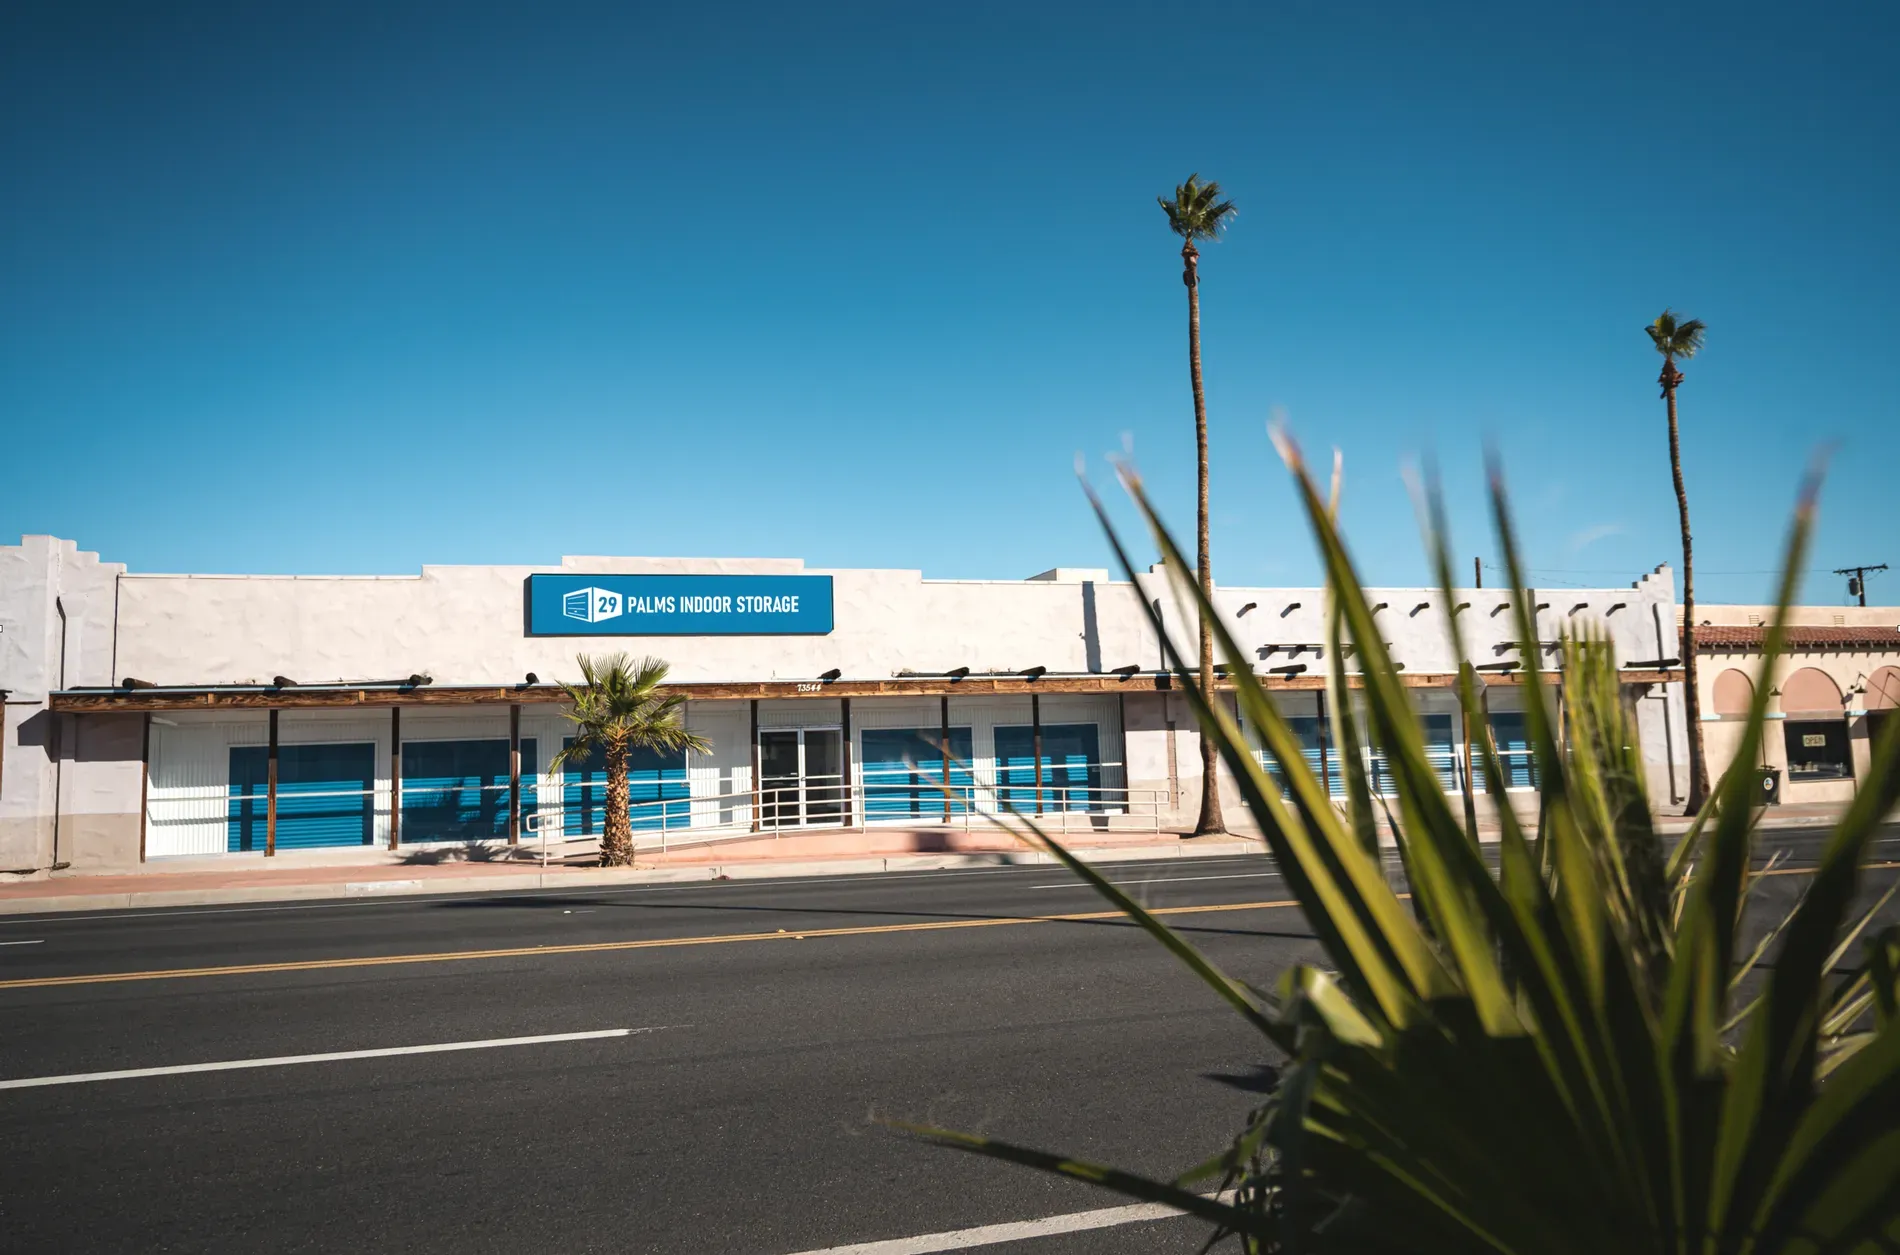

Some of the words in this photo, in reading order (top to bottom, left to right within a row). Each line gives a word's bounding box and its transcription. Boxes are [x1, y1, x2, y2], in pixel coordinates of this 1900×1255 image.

[598, 597, 617, 613] 29
[628, 596, 675, 613] PALMS
[680, 596, 731, 613] INDOOR
[737, 596, 799, 613] STORAGE
[797, 683, 822, 692] 73544
[1805, 736, 1824, 745] OPEN
